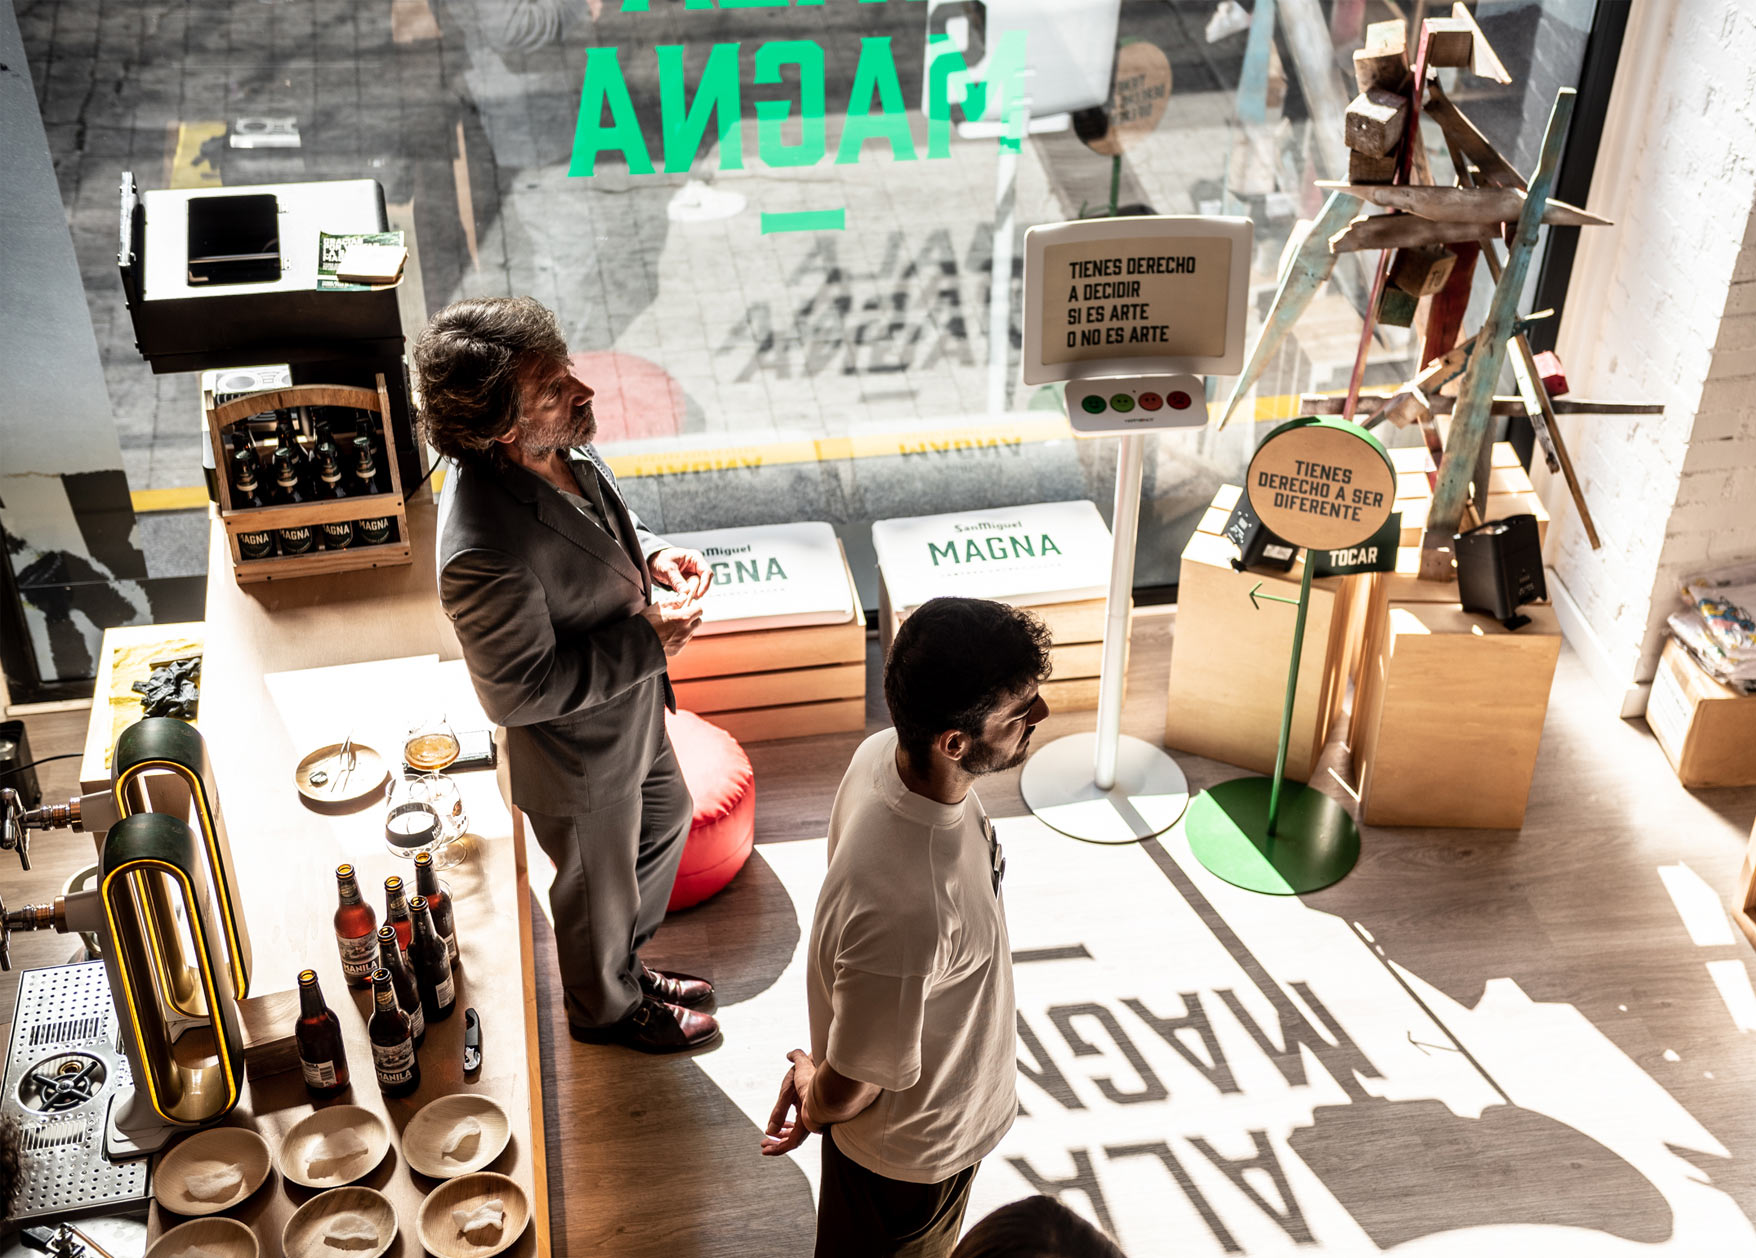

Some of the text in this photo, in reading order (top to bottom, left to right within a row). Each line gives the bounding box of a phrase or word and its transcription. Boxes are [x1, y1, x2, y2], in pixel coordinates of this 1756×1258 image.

[1069, 256, 1196, 279] TIENES DERECHO
[1068, 281, 1141, 302] A DECIDIR
[1068, 303, 1149, 325] SI ES ARTE
[1067, 325, 1169, 348] O NO ES ARTE
[1295, 460, 1352, 484] TIENES
[1258, 472, 1384, 508] DERECHO A SER
[1274, 492, 1363, 522] DIFERENTE
[324, 523, 350, 536] AGNA
[359, 517, 389, 531] MAGNA
[702, 544, 751, 556] Miguel
[927, 534, 1063, 566] MAGNA
[1329, 546, 1378, 567] TOCAR
[711, 557, 788, 586] GNA
